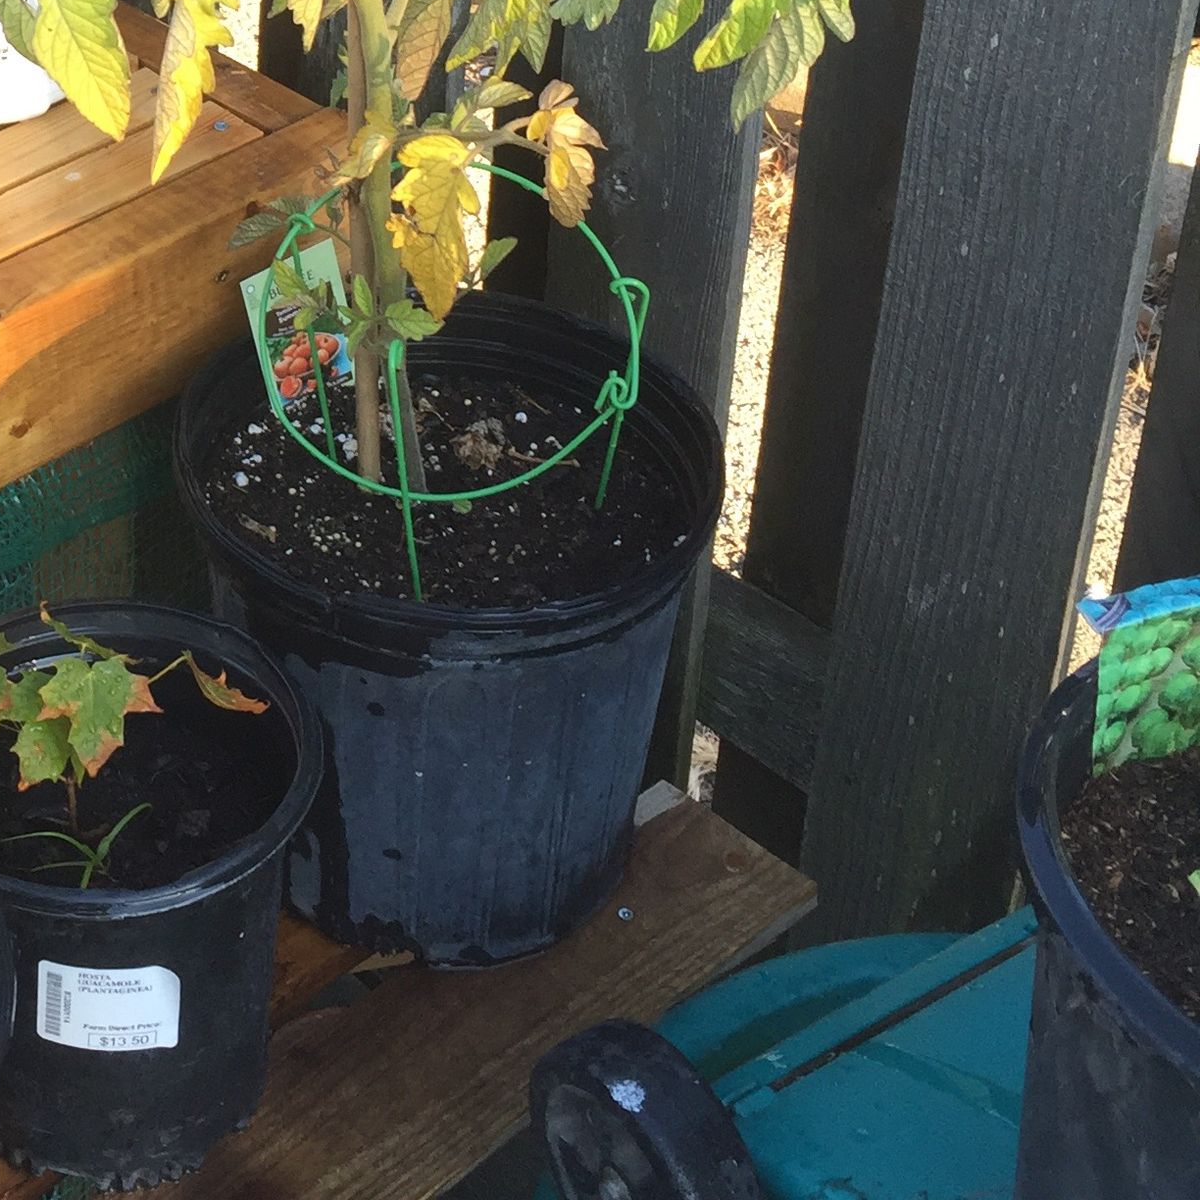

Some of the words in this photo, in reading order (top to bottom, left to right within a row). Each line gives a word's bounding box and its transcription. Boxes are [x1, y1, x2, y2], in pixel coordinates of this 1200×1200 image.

[78, 972, 112, 981] HOSTA
[78, 979, 141, 987] GUACAMOLE
[82, 1023, 107, 1031] Farm
